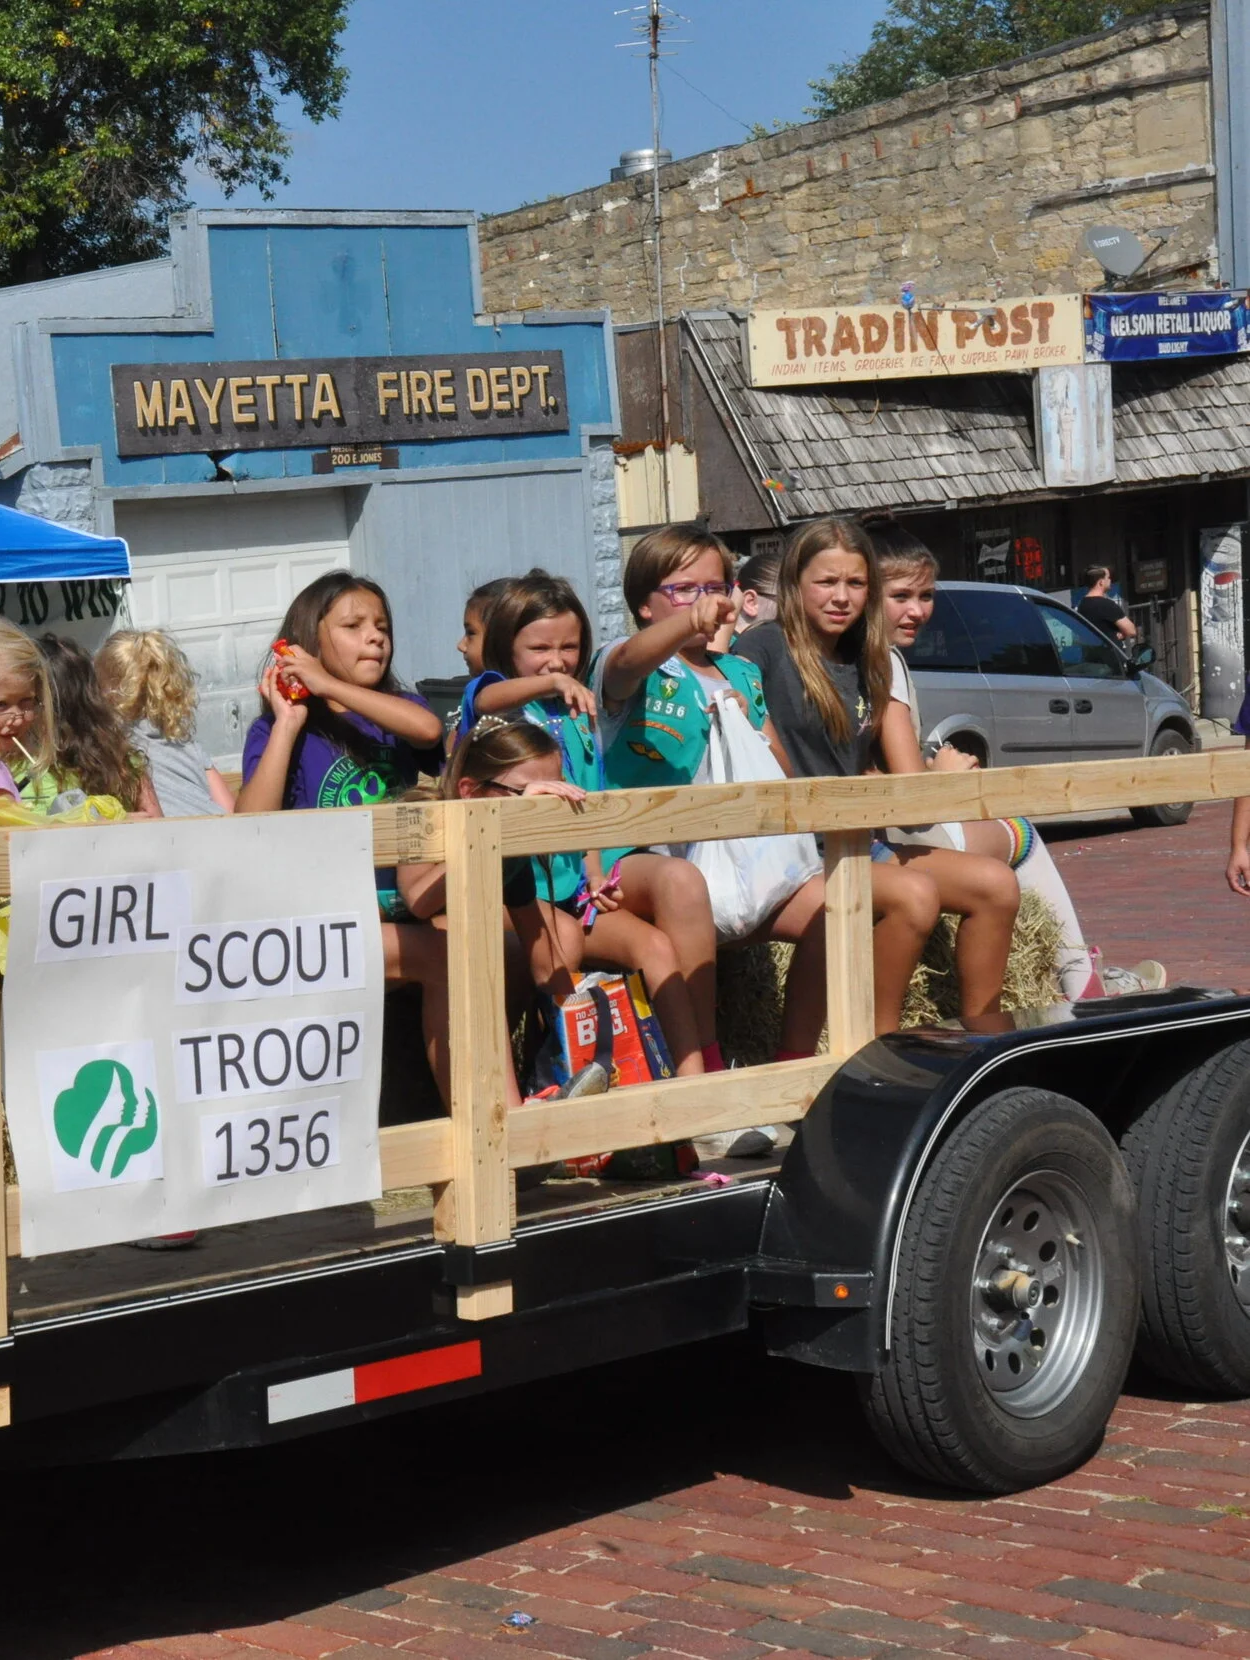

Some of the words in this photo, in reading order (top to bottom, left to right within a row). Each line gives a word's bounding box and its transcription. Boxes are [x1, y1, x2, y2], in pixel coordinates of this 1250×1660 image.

[951, 302, 1055, 349] POST
[1110, 313, 1155, 337] NELSON
[1156, 312, 1193, 335] RETAIL
[1194, 310, 1232, 336] LIQUOR
[771, 362, 807, 376] INDIAN
[813, 360, 847, 374] ITEMS
[854, 357, 904, 372] GROCERIES
[910, 355, 924, 367] ICE
[929, 353, 956, 367] FARM
[961, 350, 998, 366] SUPPLIES
[1004, 349, 1029, 361] PAWN
[1033, 345, 1068, 360] BROKER
[1158, 342, 1171, 354] BUD
[1171, 341, 1188, 353] LIGHT
[133, 373, 344, 429] MAYETTA
[377, 369, 457, 417] FIRE
[466, 364, 558, 412] DEPT.
[332, 454, 351, 465] 200
[359, 452, 382, 463] JONES
[16, 582, 50, 625] TO
[48, 882, 171, 950] GIRL
[183, 920, 358, 994] SCOUT
[576, 1007, 628, 1047] BG,
[179, 1019, 361, 1096] TROOP
[214, 1109, 332, 1182] 1356
